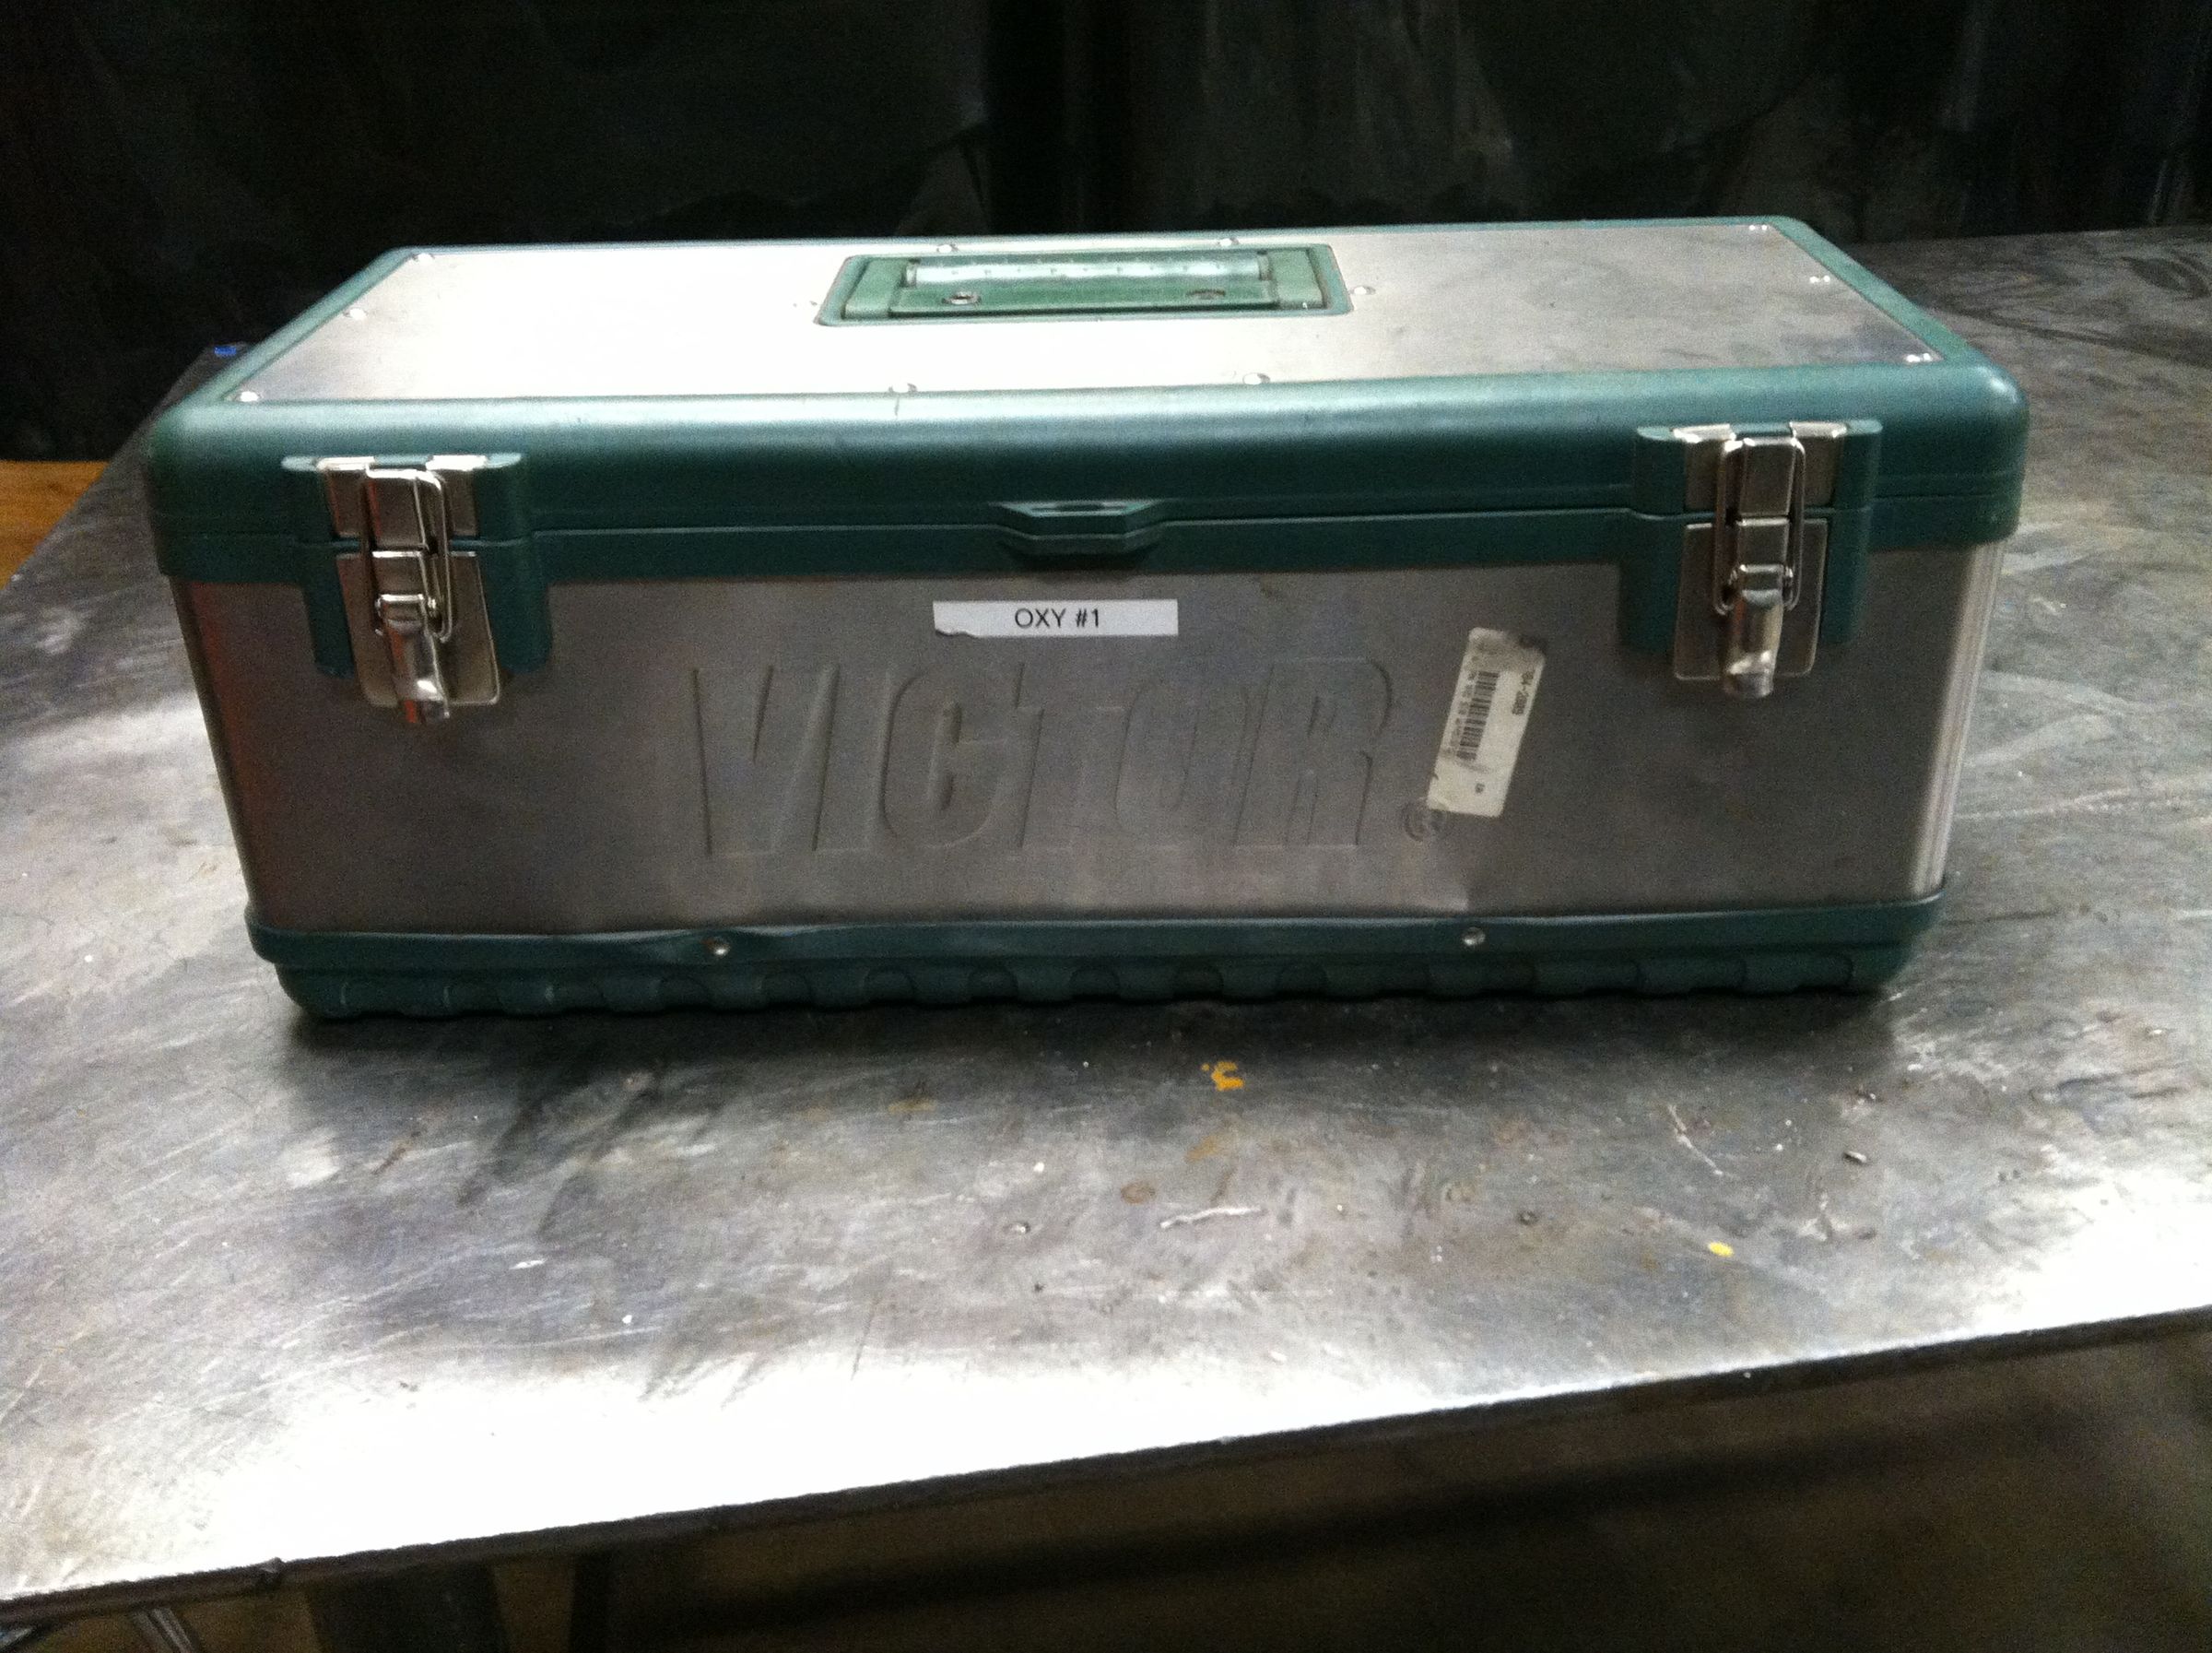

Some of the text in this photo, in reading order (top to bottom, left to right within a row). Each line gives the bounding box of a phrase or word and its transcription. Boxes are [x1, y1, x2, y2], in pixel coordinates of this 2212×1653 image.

[1014, 608, 1100, 629] OXY #1
[691, 656, 1394, 856] VICTOR
